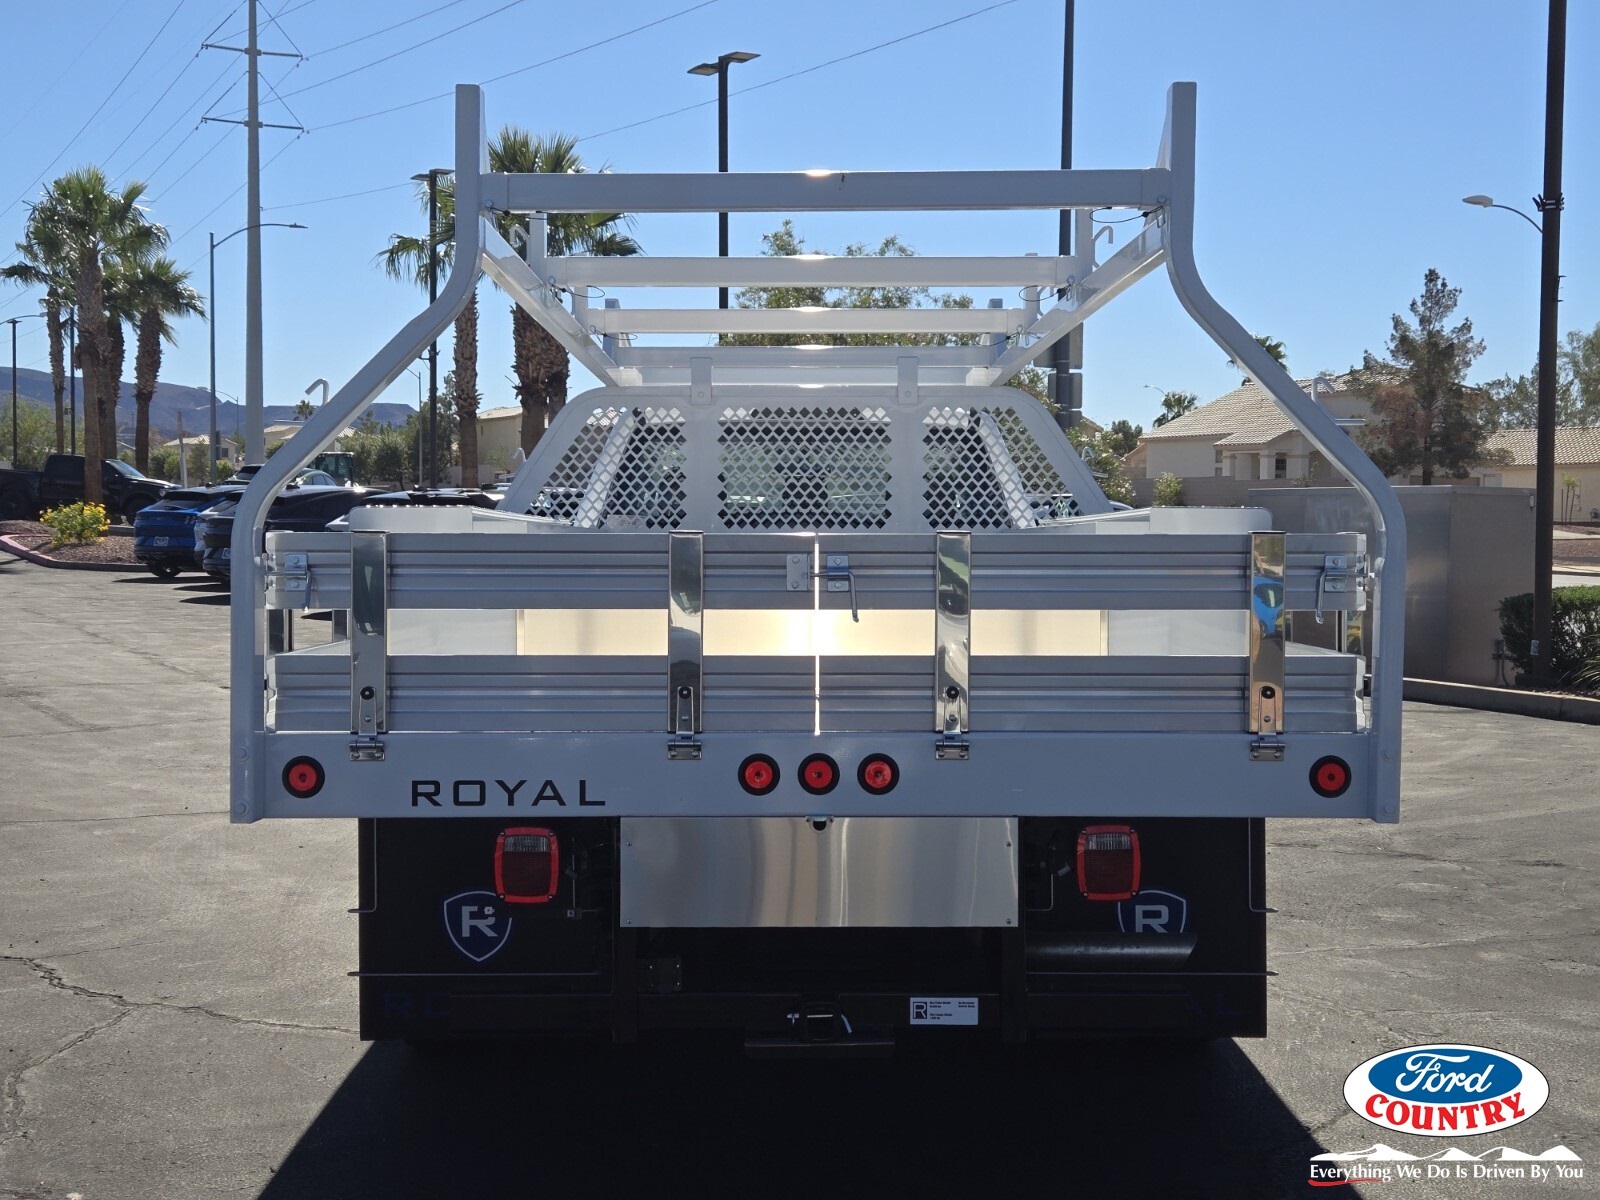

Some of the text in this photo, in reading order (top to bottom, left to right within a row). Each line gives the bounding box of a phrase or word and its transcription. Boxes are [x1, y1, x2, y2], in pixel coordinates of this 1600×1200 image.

[411, 779, 606, 807] ROYAL
[1135, 904, 1169, 933] R
[913, 1002, 927, 1019] R
